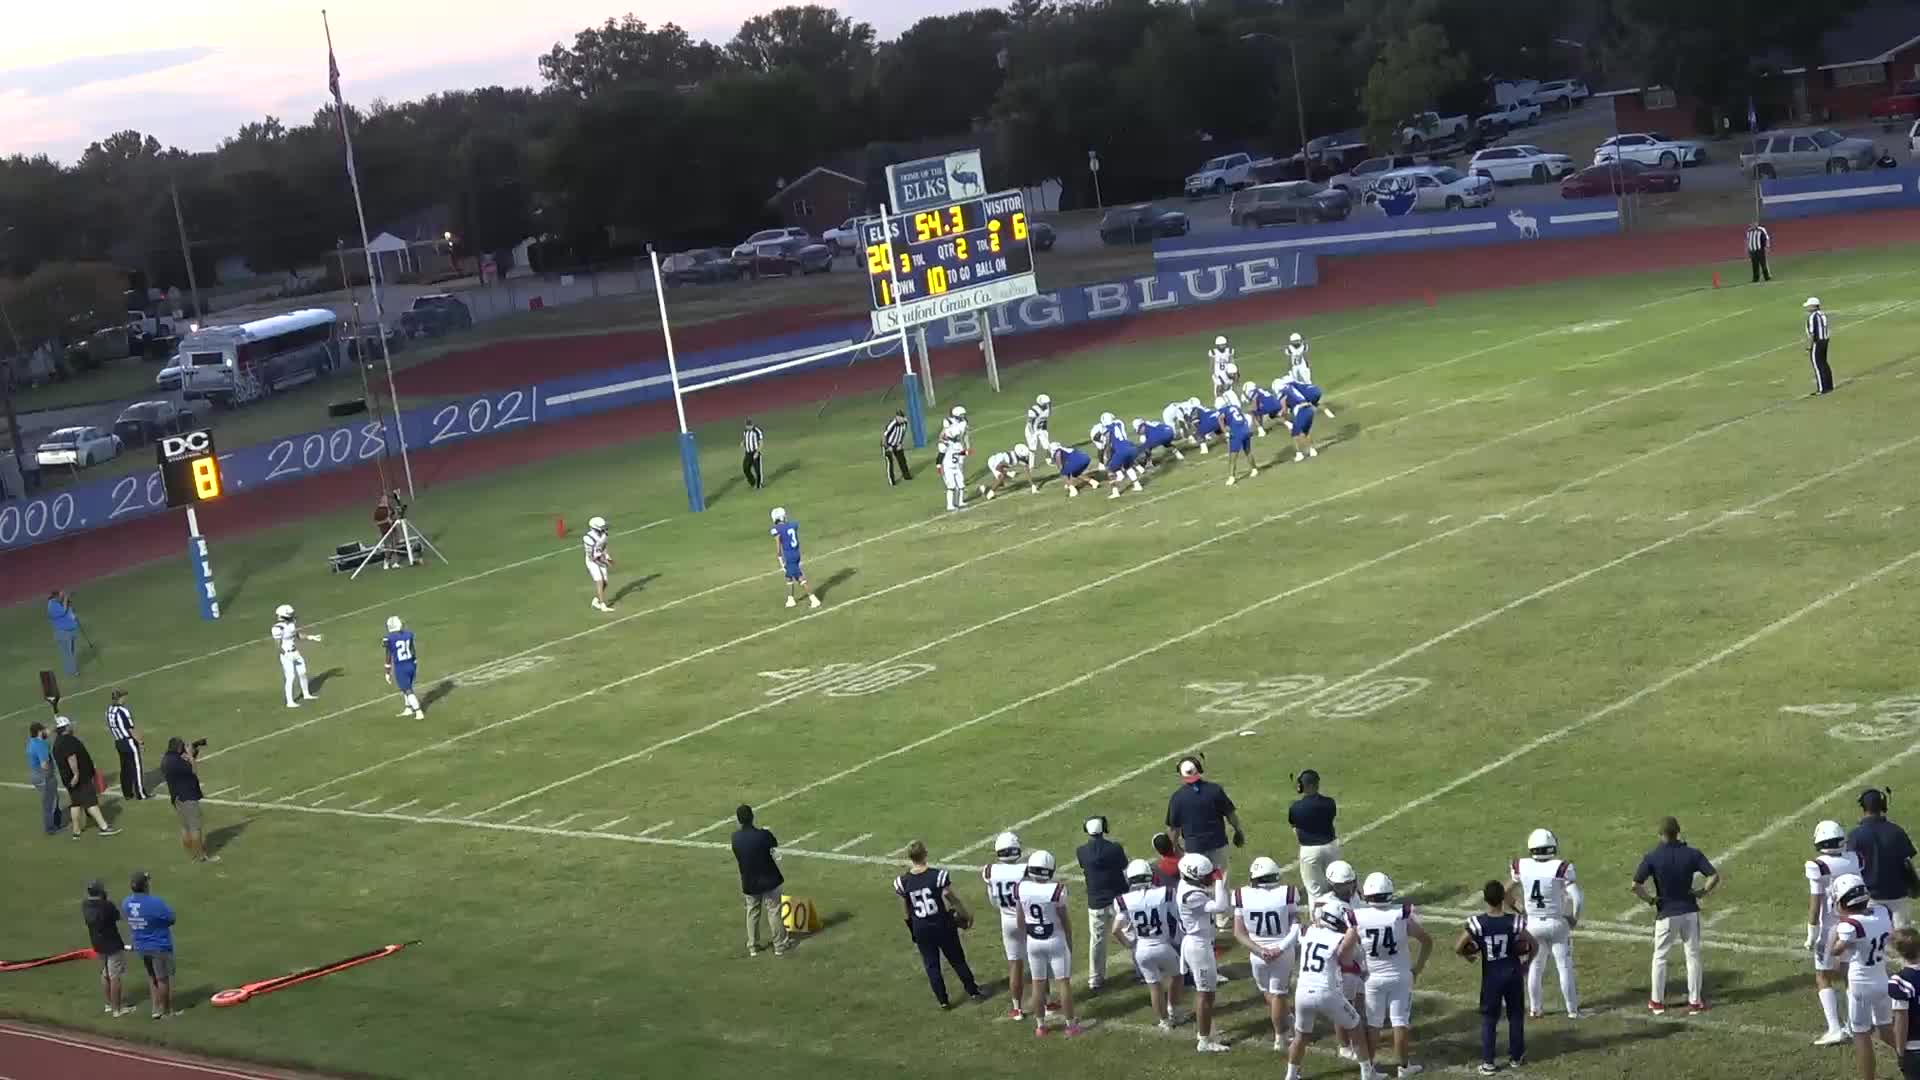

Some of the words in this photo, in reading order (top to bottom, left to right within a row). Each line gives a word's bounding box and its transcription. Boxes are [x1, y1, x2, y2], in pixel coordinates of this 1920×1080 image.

[903, 177, 946, 203] ELKS
[985, 196, 1021, 216] VISITOR
[915, 206, 964, 241] 54.3
[1012, 213, 1027, 240] 6
[937, 242, 956, 260] QTR
[956, 237, 968, 260] 2
[976, 239, 989, 252] TOL
[989, 232, 1000, 252] 2
[900, 253, 911, 273] 3
[912, 252, 926, 267] TOL
[975, 260, 994, 277] BALL
[995, 257, 1007, 272] ON
[927, 265, 947, 294] 10
[947, 269, 957, 284] TO
[960, 265, 970, 280] GO
[881, 279, 890, 305] 1
[944, 293, 1065, 344] BIG
[1084, 255, 1282, 320] BLUE
[974, 289, 992, 304] Co.
[429, 386, 538, 445] 2021
[191, 457, 220, 500] 8
[787, 528, 798, 548] 3
[395, 639, 413, 661] 21
[910, 887, 939, 918] 56
[1531, 879, 1546, 909] 4
[781, 901, 807, 929] 20
[1029, 903, 1045, 925] 9
[1134, 908, 1163, 937] 24
[1249, 910, 1282, 937] 70
[1365, 925, 1398, 957] 74
[1484, 934, 1509, 961] 17
[1302, 941, 1330, 973] 15
